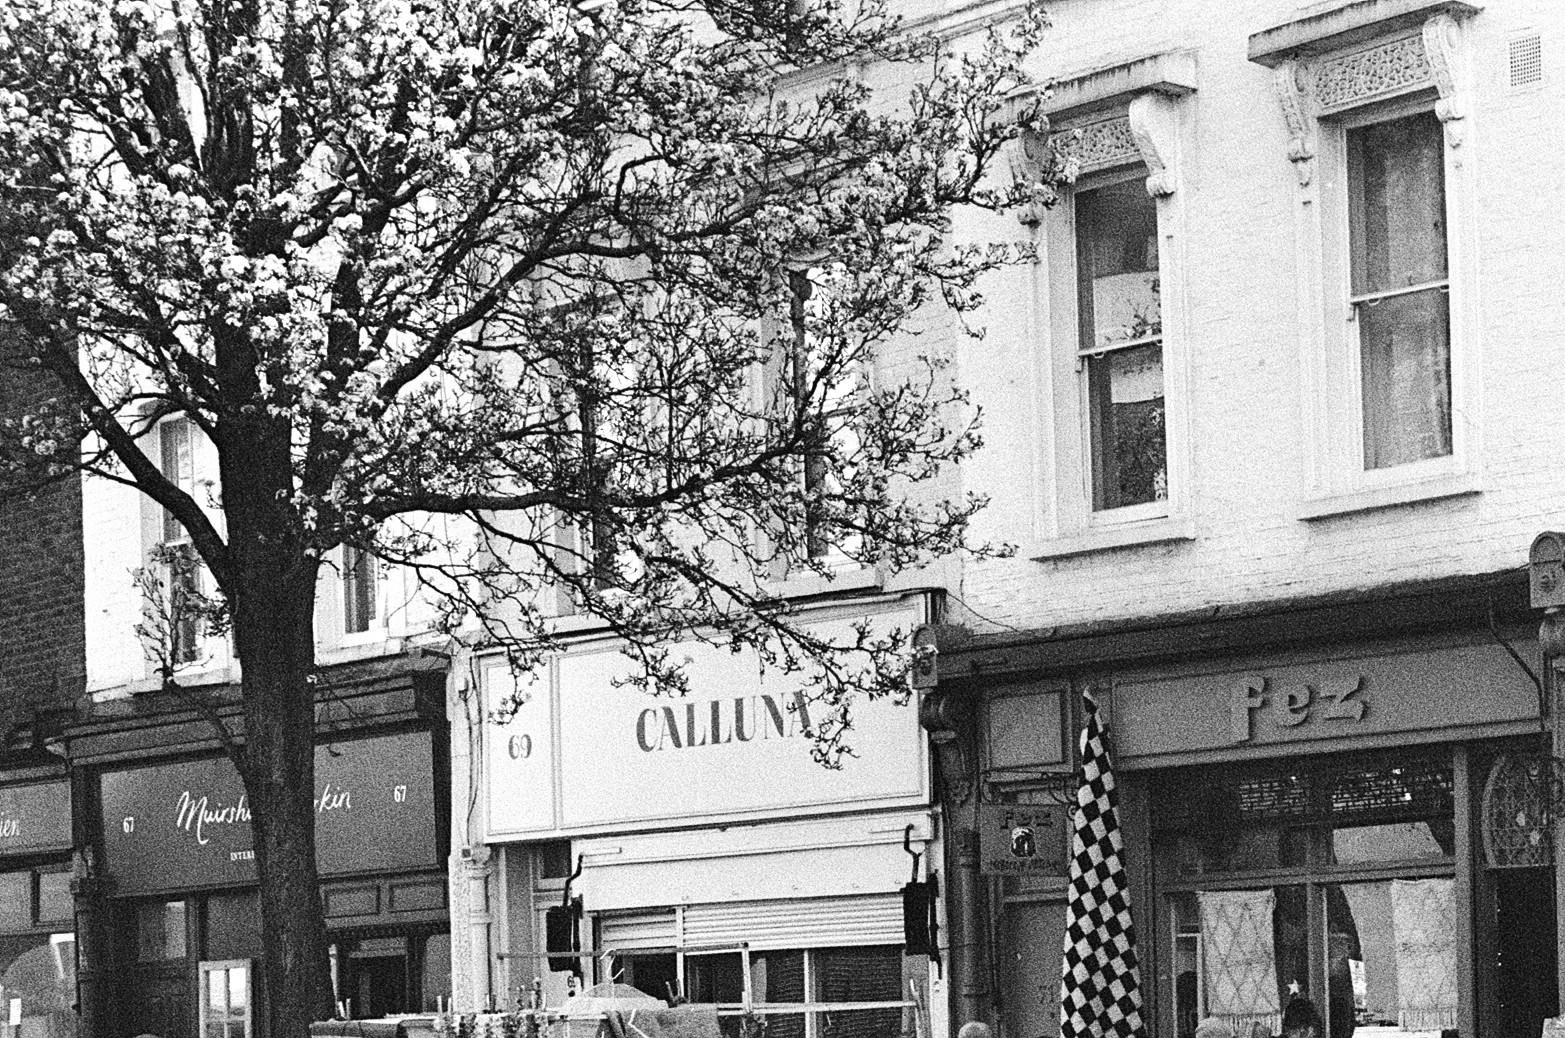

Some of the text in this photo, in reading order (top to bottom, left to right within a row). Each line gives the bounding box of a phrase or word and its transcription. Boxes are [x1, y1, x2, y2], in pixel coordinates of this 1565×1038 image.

[636, 689, 811, 753] CALLUNA
[508, 733, 532, 760] 69
[394, 785, 407, 803] 67
[123, 817, 134, 833] 67
